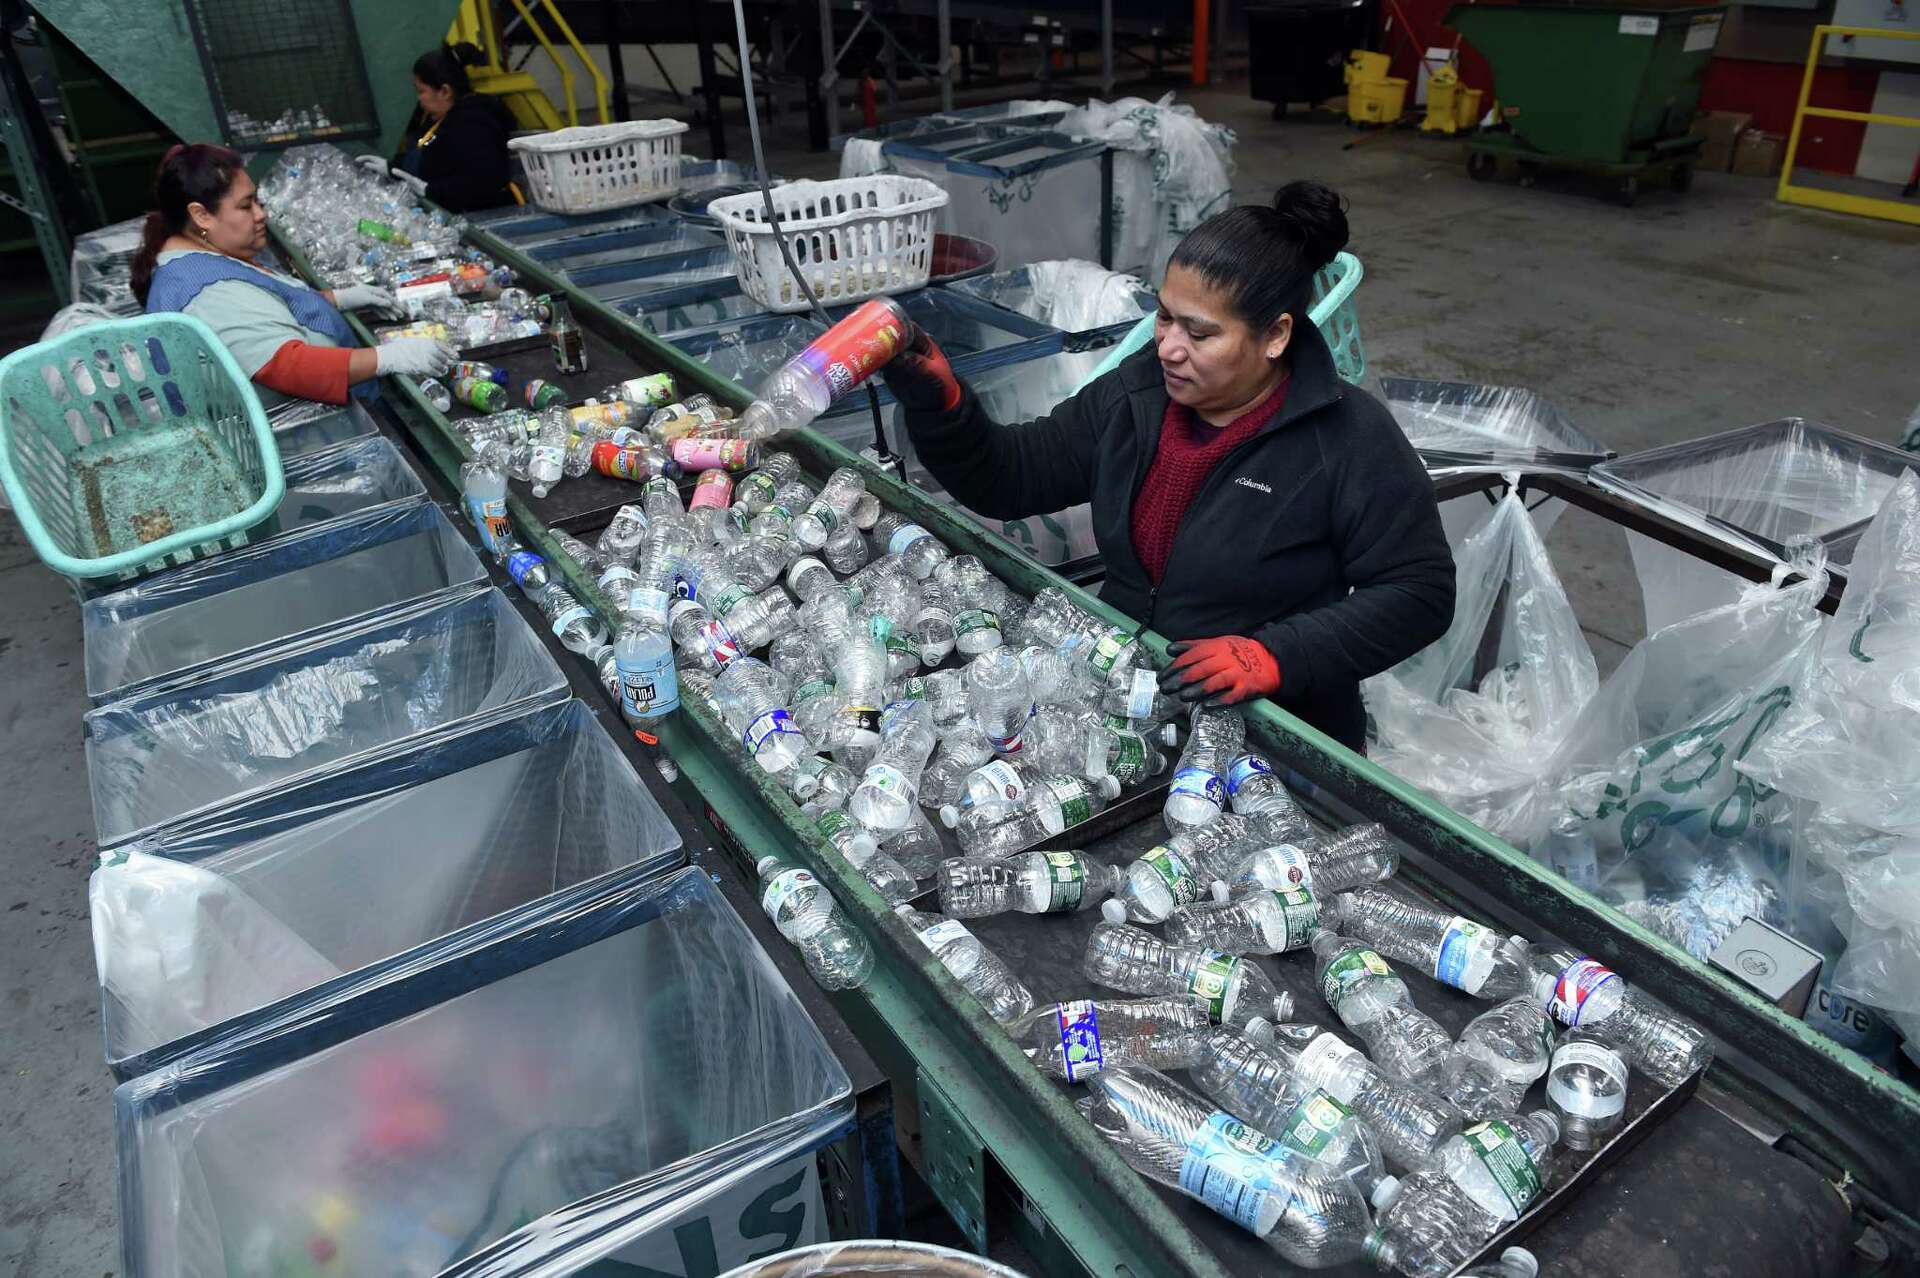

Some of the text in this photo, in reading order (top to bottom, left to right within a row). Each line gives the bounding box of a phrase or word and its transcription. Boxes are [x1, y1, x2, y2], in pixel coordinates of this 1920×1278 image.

[1239, 477, 1272, 493] Columbia
[626, 685, 653, 700] POLAR
[1819, 990, 1869, 1032] core
